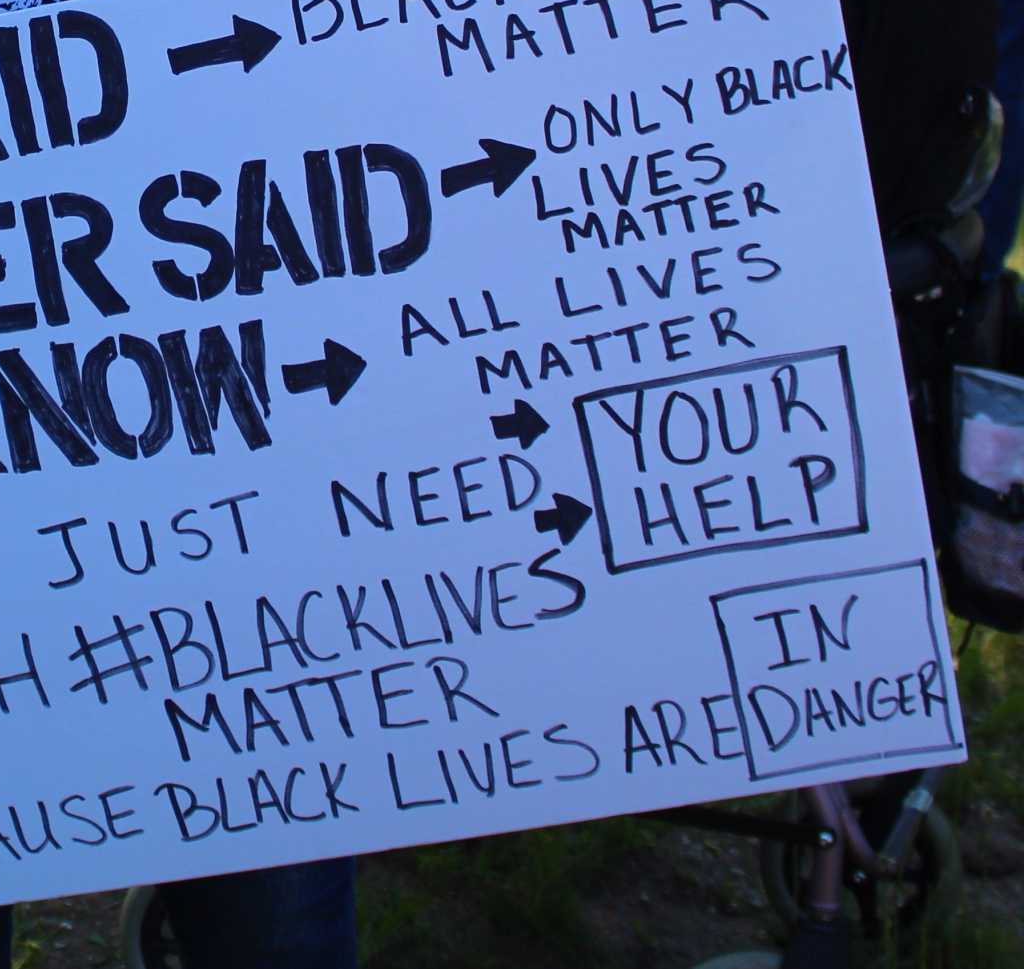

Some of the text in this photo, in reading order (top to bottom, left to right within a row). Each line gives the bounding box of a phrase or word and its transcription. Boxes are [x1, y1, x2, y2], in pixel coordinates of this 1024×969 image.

[543, 42, 854, 155] ONLY BLACK
[137, 142, 433, 303] SAID
[531, 142, 728, 222] LIVES
[561, 181, 781, 254] MATTER
[401, 242, 783, 357] ALL LIVES
[474, 306, 756, 395] MATTER
[598, 363, 829, 473] YOUR
[36, 490, 260, 590] JUST
[330, 453, 543, 538] NEED
[632, 454, 837, 548] HELP
[752, 594, 859, 672] IN
[163, 655, 501, 763] MATTER
[746, 660, 947, 753] DANGER
[152, 761, 361, 843] BLACK
[386, 723, 602, 812] LIVES
[623, 693, 745, 775] ARE
